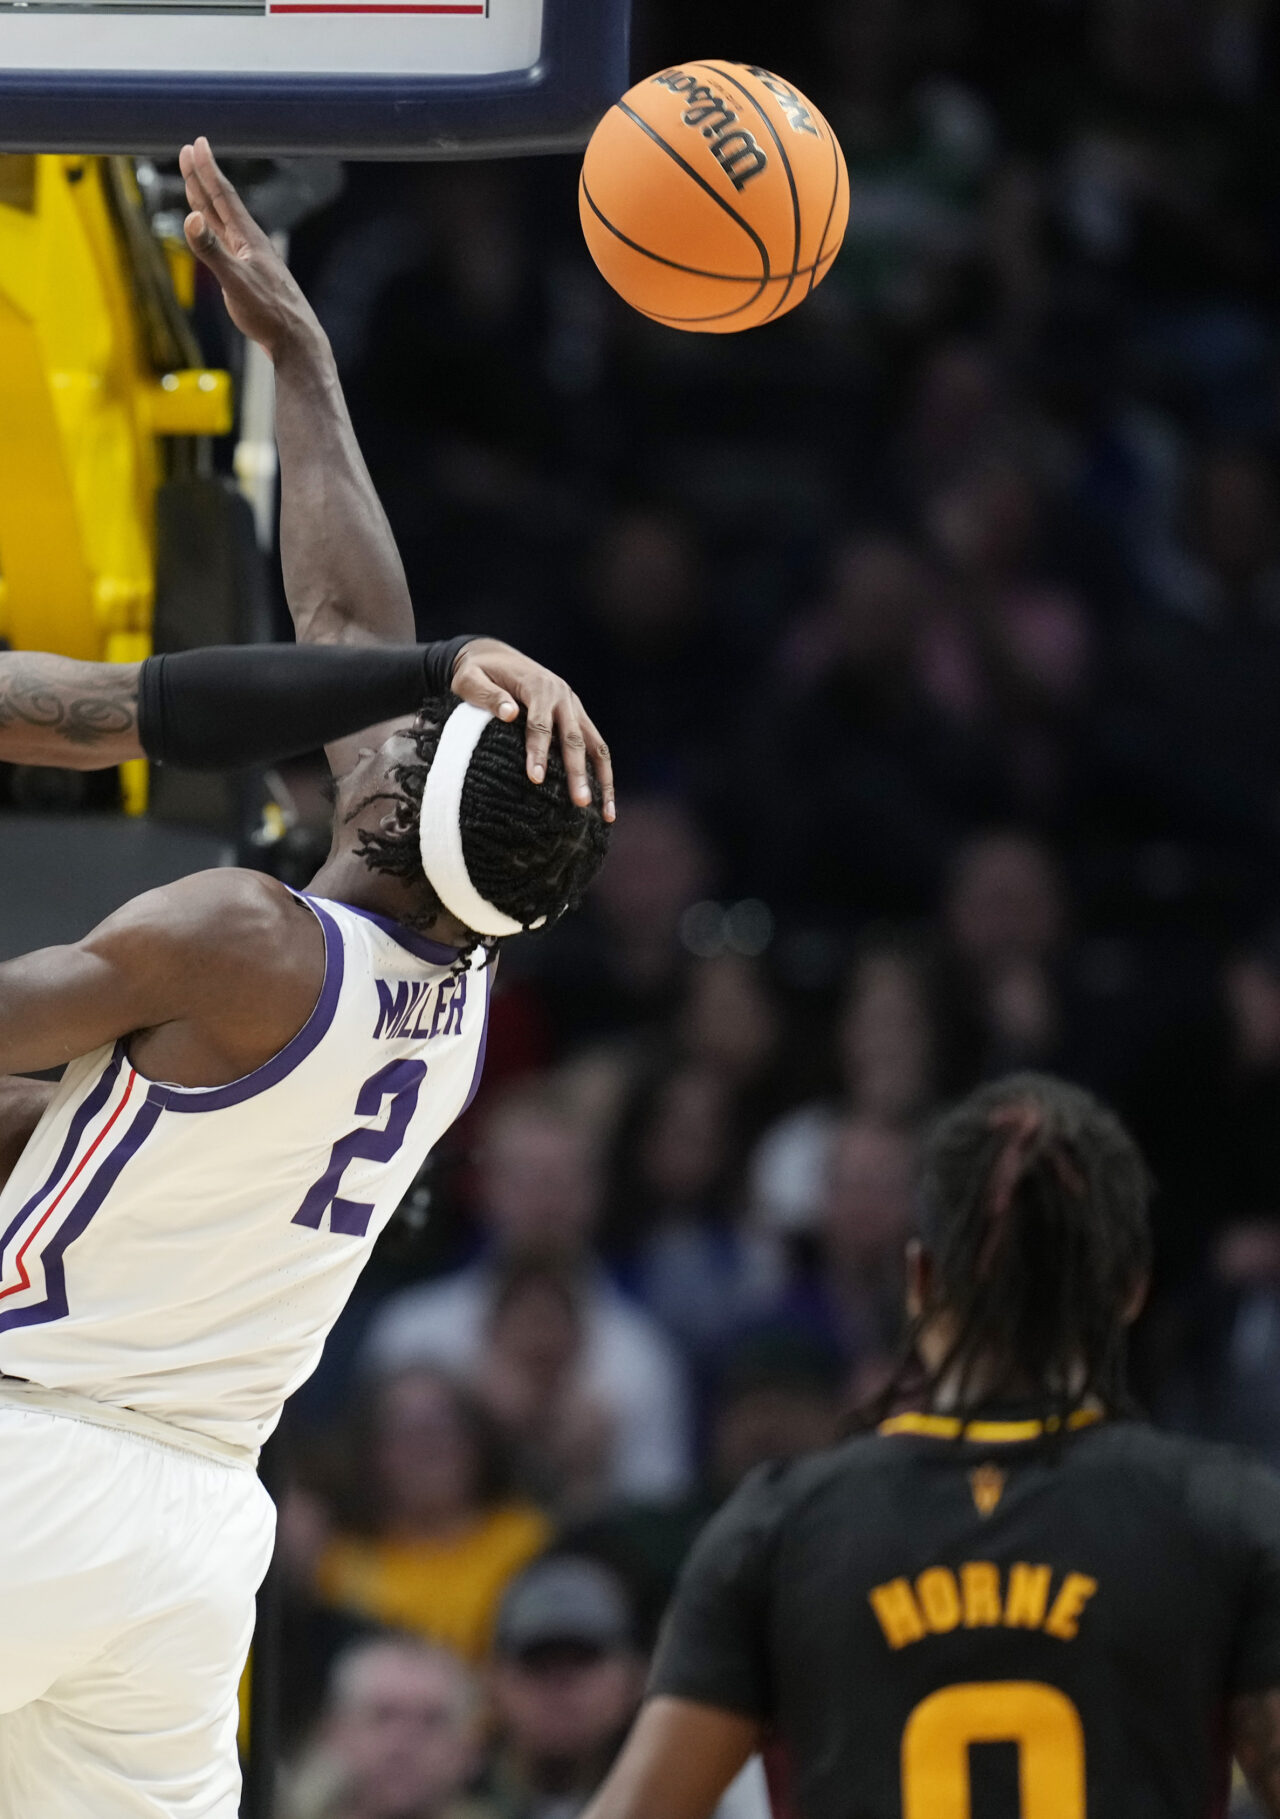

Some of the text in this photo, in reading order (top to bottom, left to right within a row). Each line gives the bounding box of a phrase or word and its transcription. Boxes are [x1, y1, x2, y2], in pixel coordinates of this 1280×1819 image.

[651, 69, 767, 192] Wilson
[372, 972, 467, 1040] MILLER
[290, 1058, 428, 1238] 2
[870, 1560, 1099, 1651] HORNE
[900, 1679, 1087, 1819] 0
